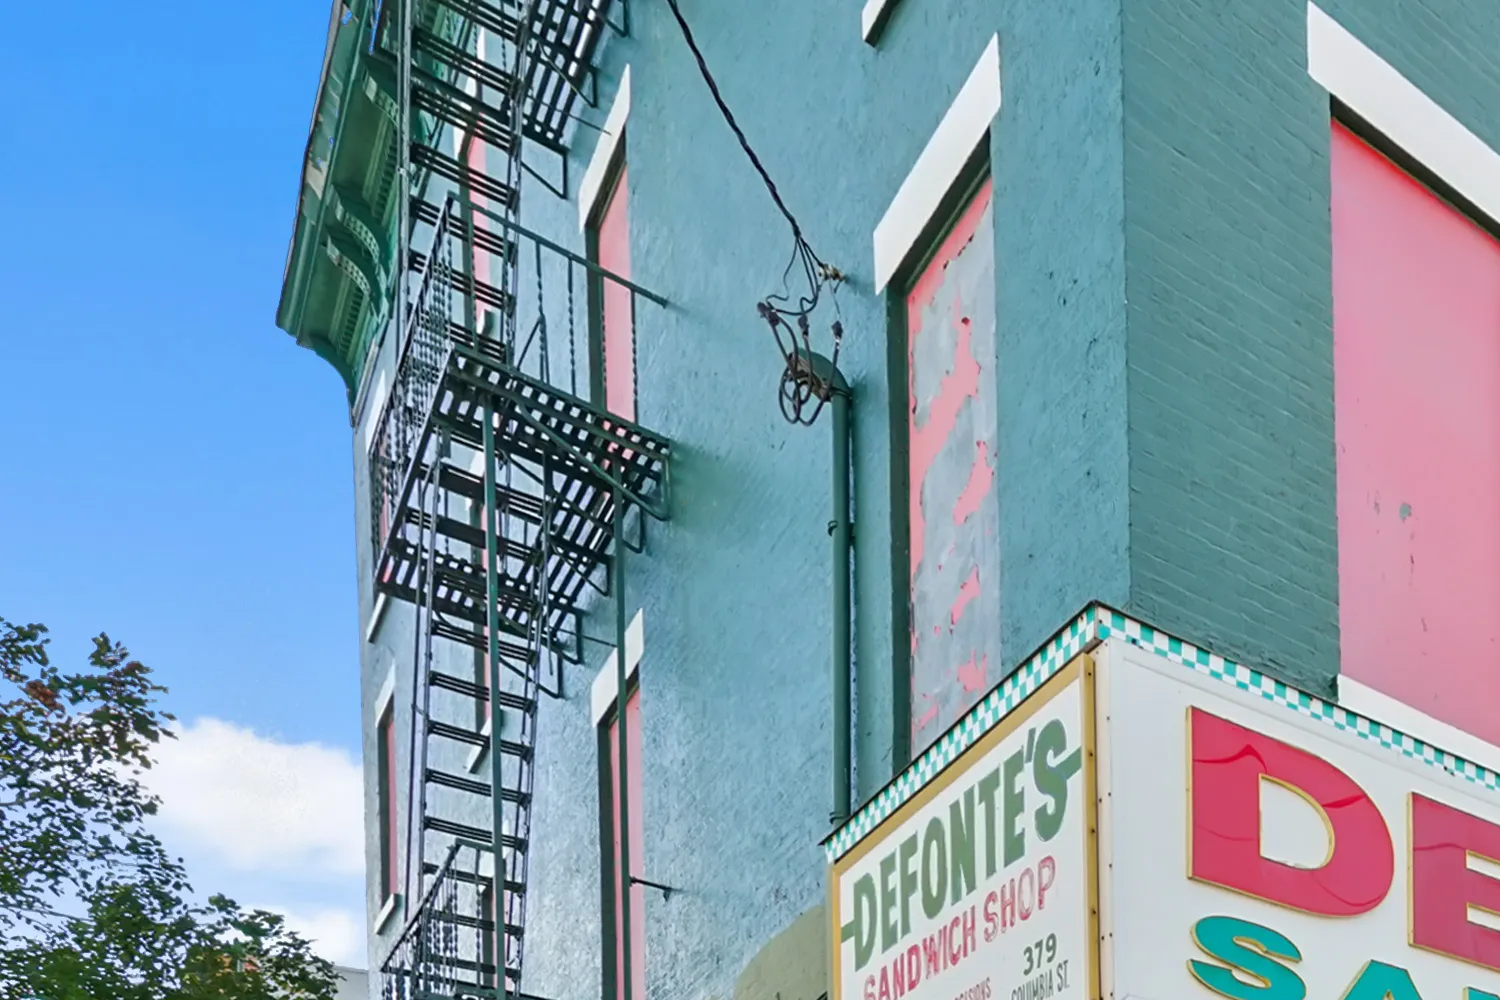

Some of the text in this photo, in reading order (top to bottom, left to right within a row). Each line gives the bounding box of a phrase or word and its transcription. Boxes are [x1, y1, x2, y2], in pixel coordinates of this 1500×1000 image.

[852, 717, 1069, 973] DEFONTE'S
[984, 855, 1056, 942] SHOP
[1022, 933, 1058, 976] 379
